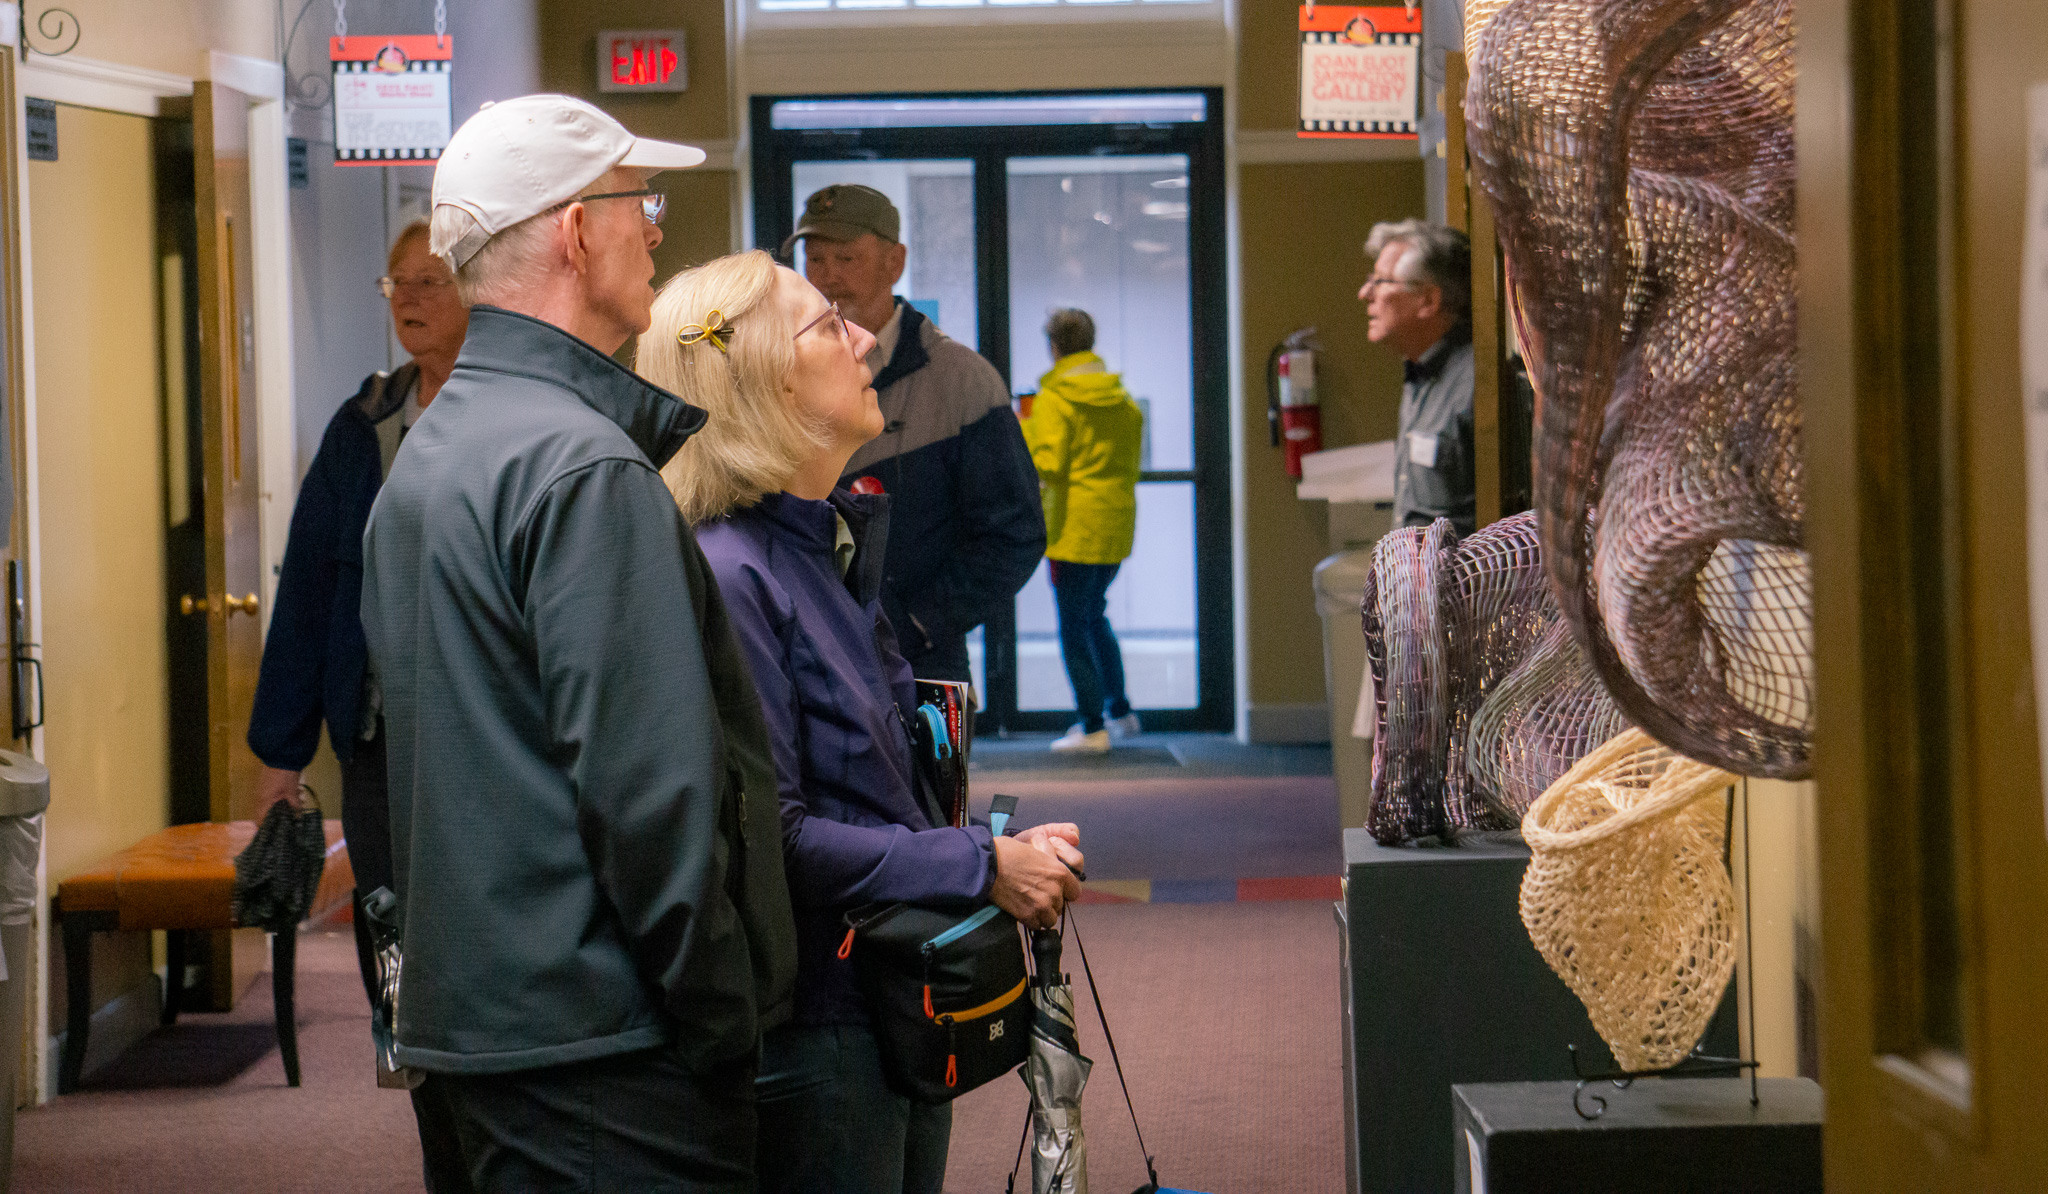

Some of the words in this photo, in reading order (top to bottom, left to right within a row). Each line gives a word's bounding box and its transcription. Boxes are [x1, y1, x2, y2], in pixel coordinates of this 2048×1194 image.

[611, 38, 678, 85] EXIT
[1313, 54, 1356, 68] JOAN
[1362, 55, 1406, 70] ELIOT
[1312, 82, 1406, 102] GALLERY
